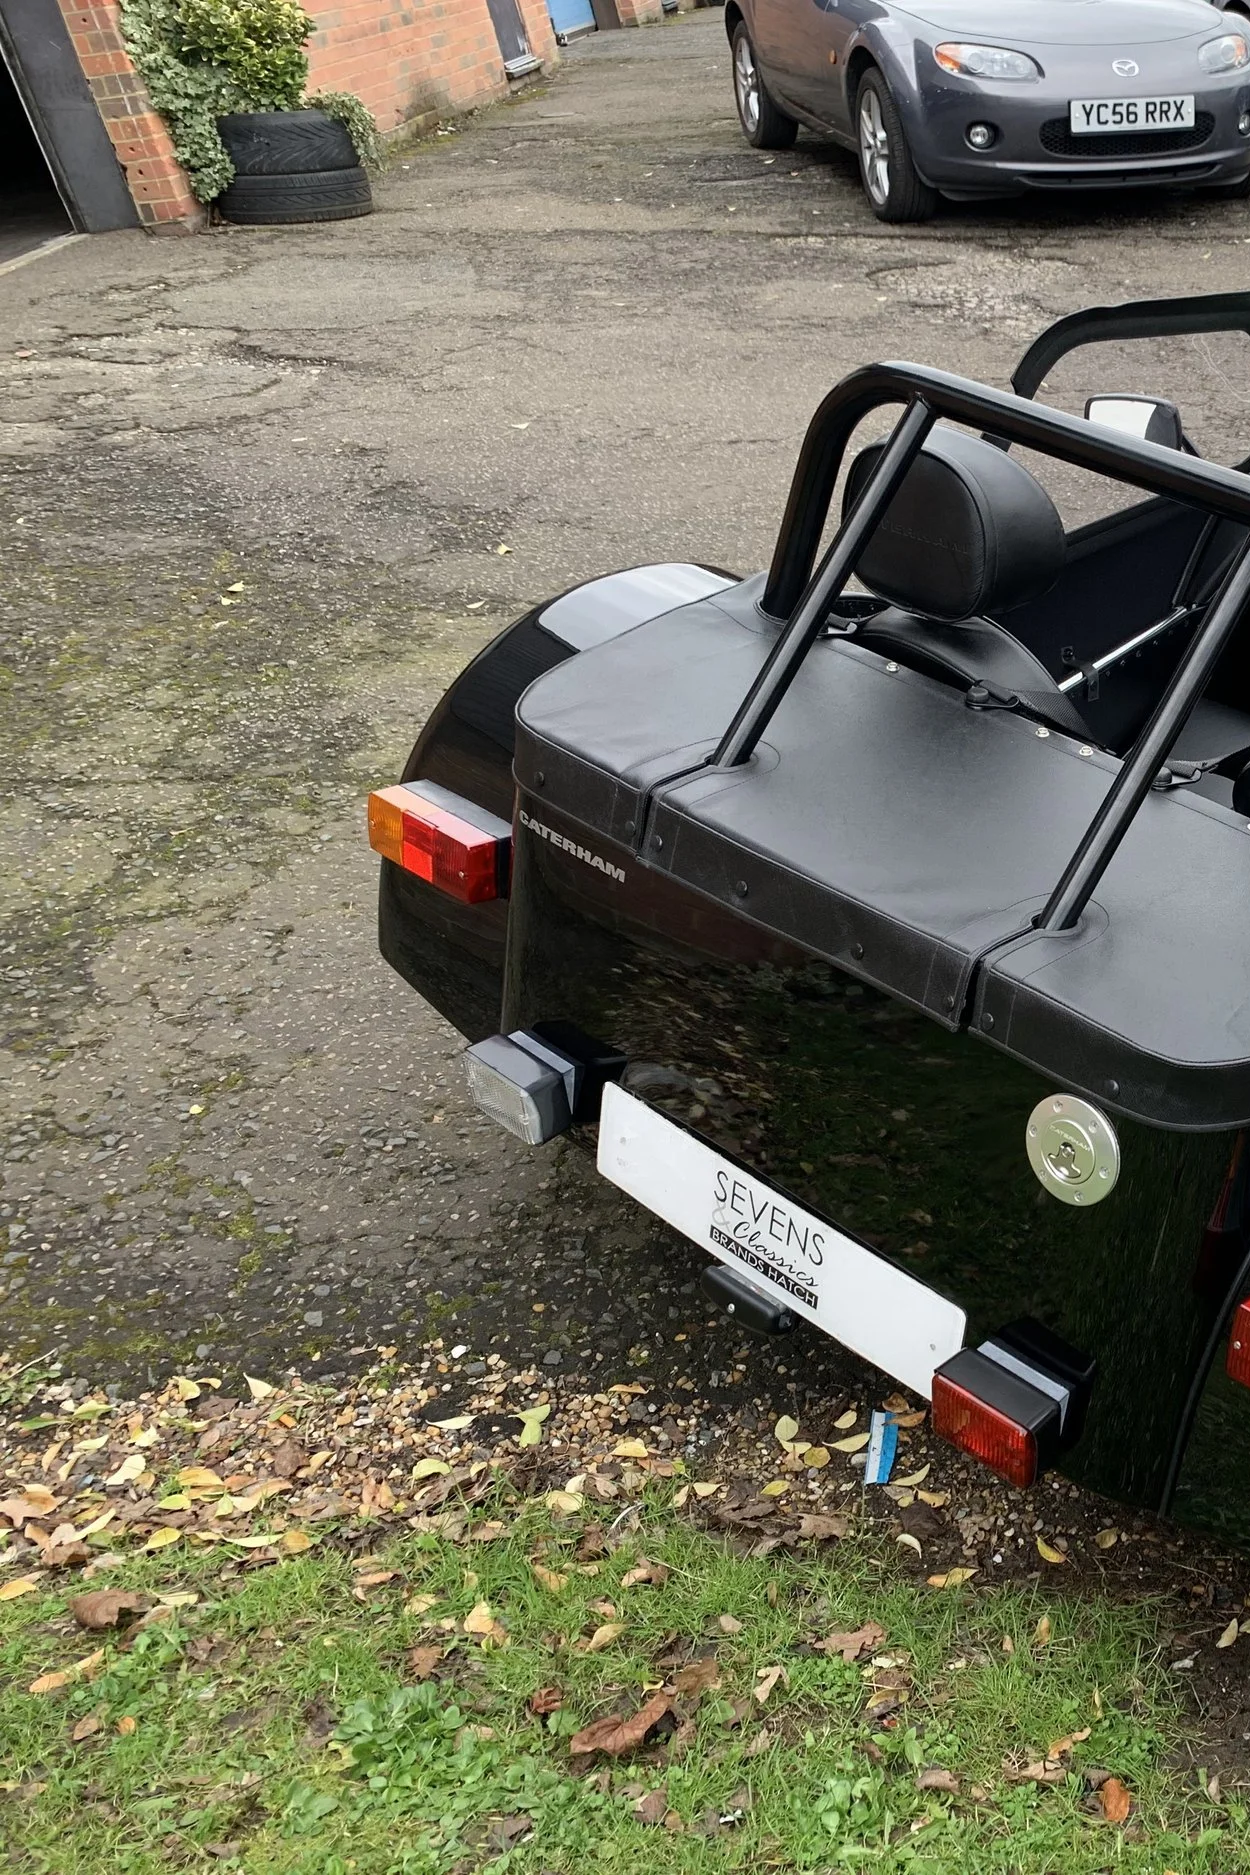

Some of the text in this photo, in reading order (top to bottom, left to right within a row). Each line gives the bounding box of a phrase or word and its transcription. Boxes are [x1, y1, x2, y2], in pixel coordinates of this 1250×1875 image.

[1081, 100, 1185, 126] YC56 RRX
[519, 809, 626, 883] CATERHAM
[713, 1170, 826, 1266] SEVENS
[732, 1221, 820, 1288] Classics
[711, 1228, 816, 1308] BRANDS HATCH
